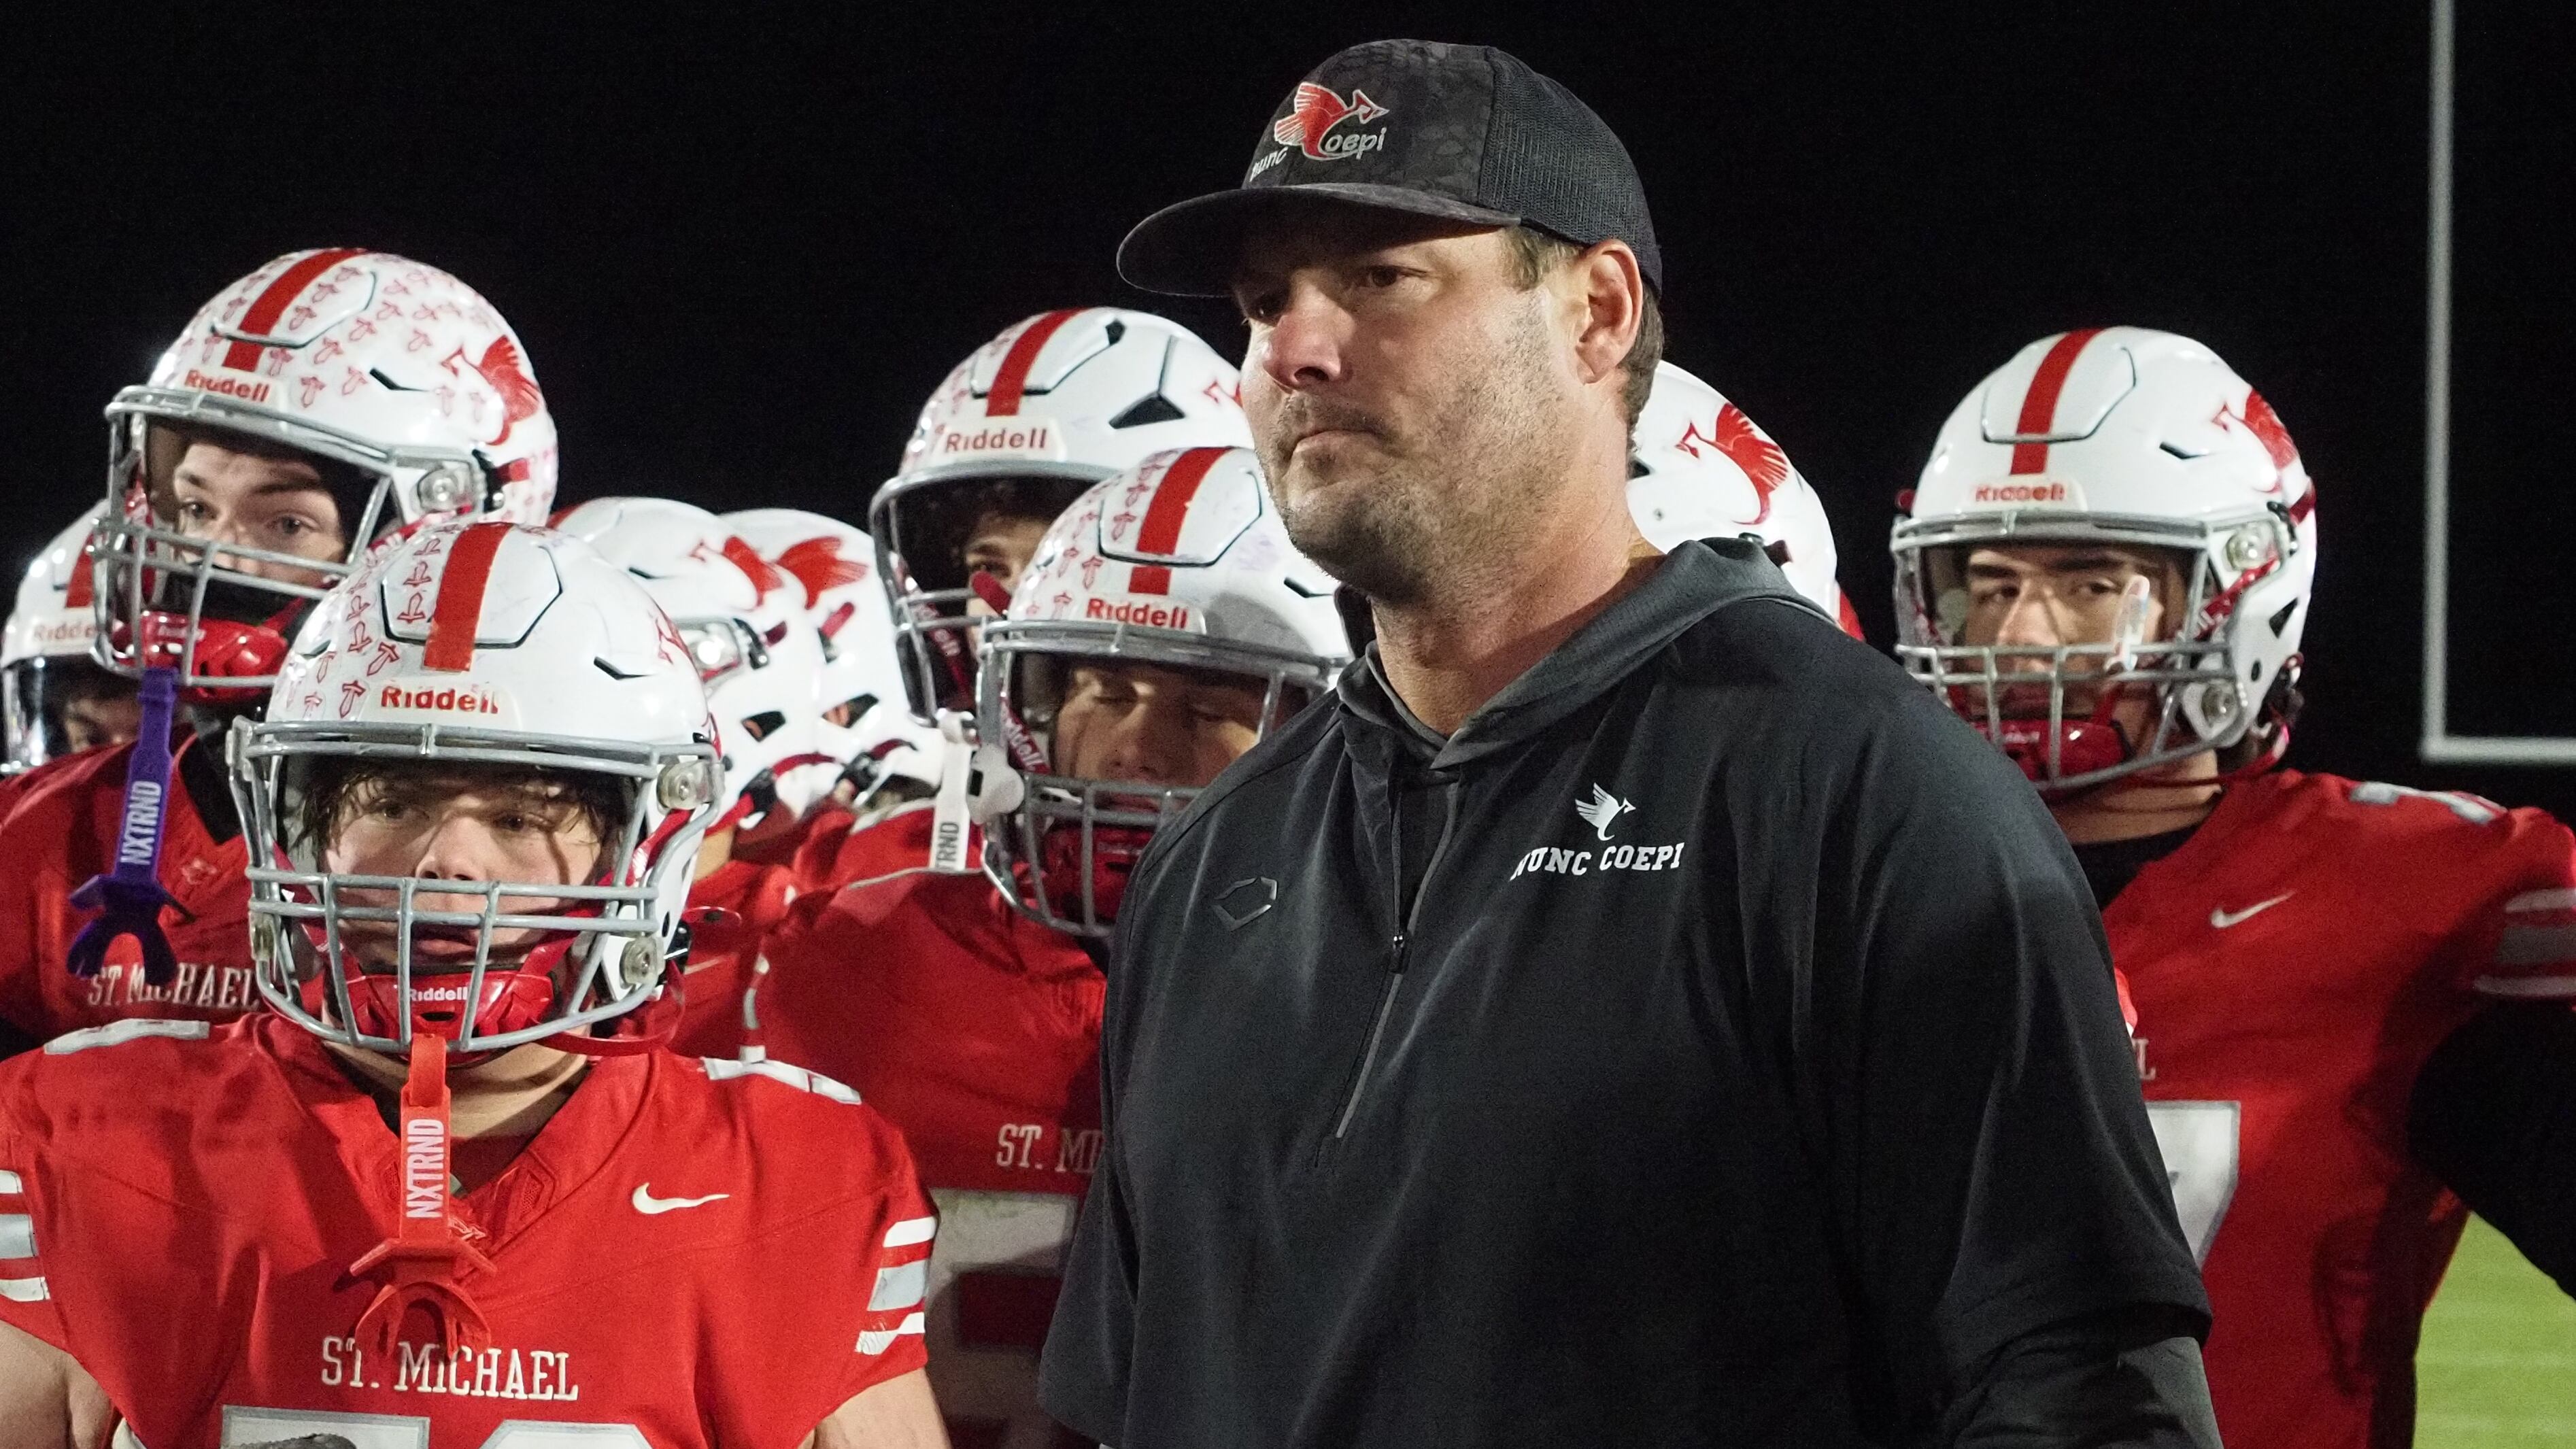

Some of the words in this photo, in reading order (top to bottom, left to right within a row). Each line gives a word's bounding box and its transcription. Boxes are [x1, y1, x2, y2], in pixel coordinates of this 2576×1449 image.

[945, 428, 1047, 453] Riddell
[35, 622, 96, 641] Ridde
[1086, 598, 1189, 629] Riddell
[381, 686, 498, 714] Riddell
[120, 781, 162, 866] NXTRND
[1509, 847, 1592, 881] NUNC
[1599, 842, 1685, 871] COEPI
[997, 1123, 1043, 1170] ST.
[407, 1119, 444, 1218] NXTRND
[322, 1335, 379, 1388] ST.
